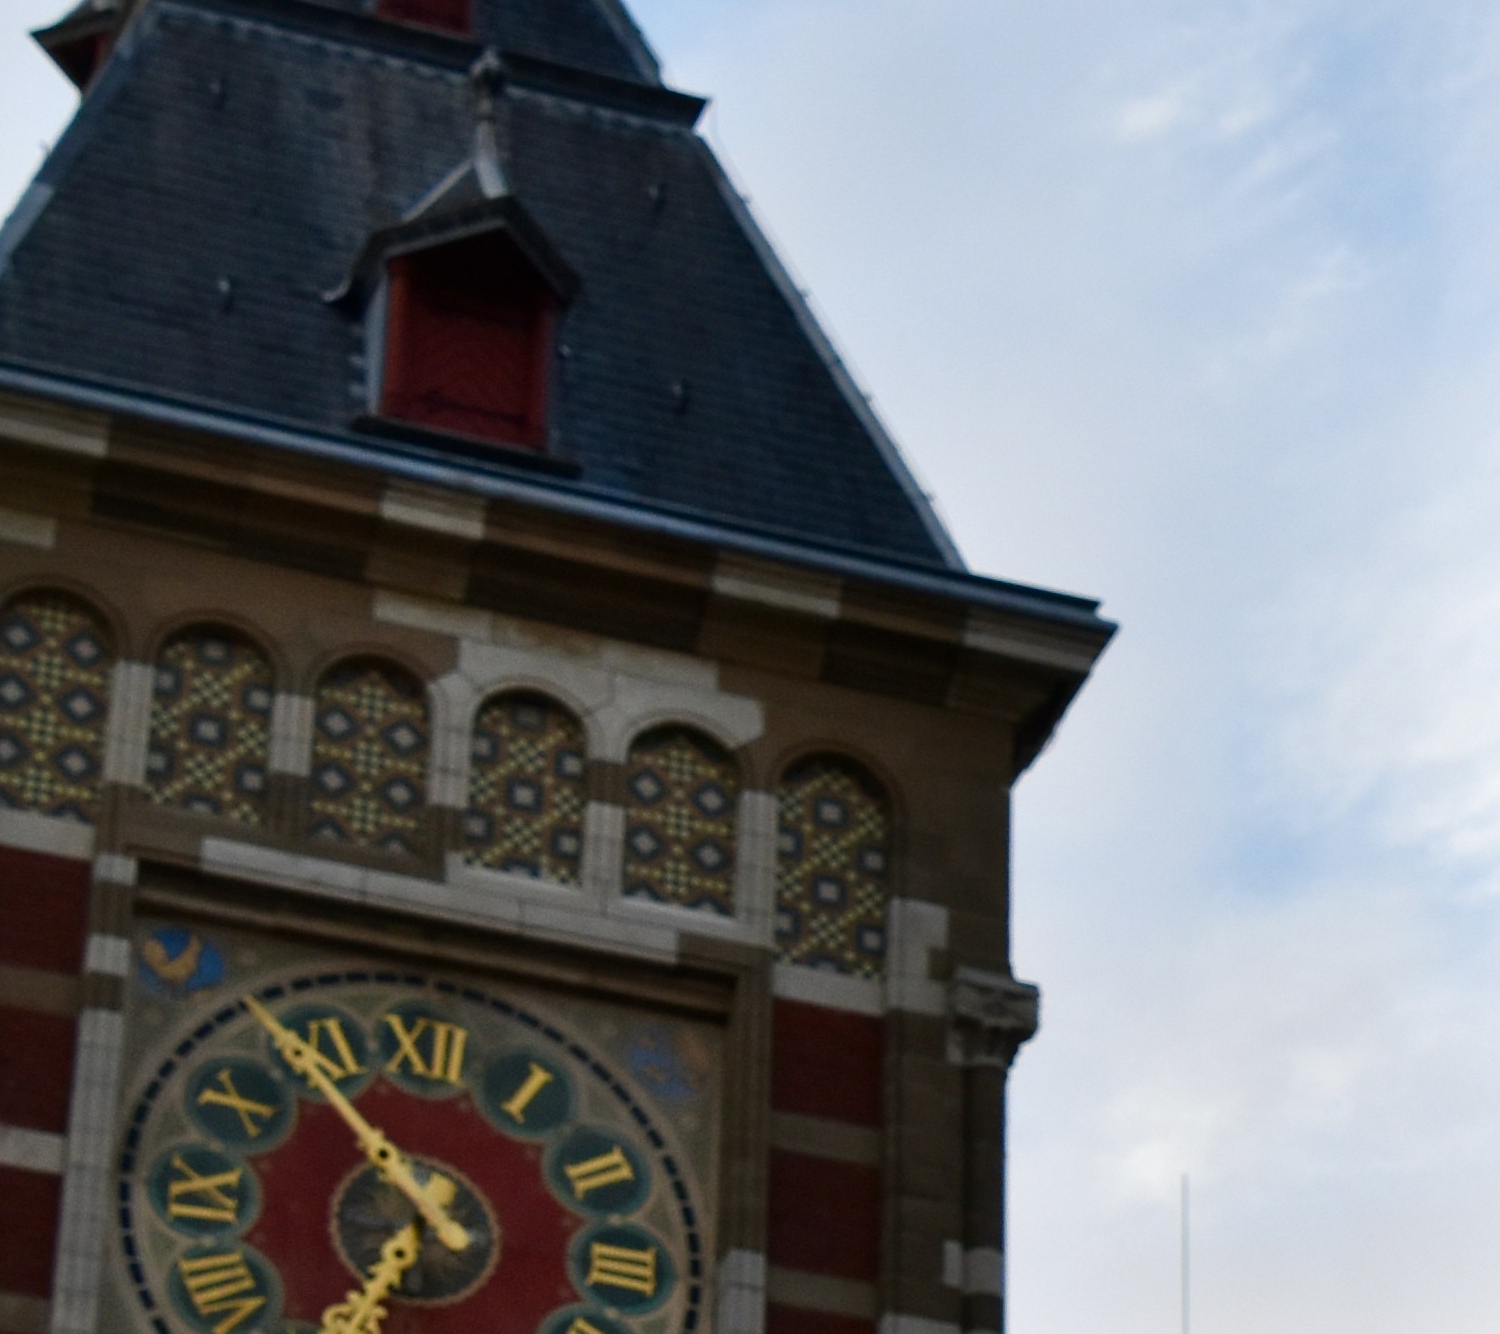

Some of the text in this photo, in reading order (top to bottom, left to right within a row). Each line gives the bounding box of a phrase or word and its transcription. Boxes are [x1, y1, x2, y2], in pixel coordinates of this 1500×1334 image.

[384, 1013, 468, 1085] XII
[198, 1068, 274, 1137] X
[503, 1062, 553, 1124] I
[167, 1154, 242, 1224] IX
[564, 1146, 635, 1201] II
[587, 1242, 657, 1298] III
